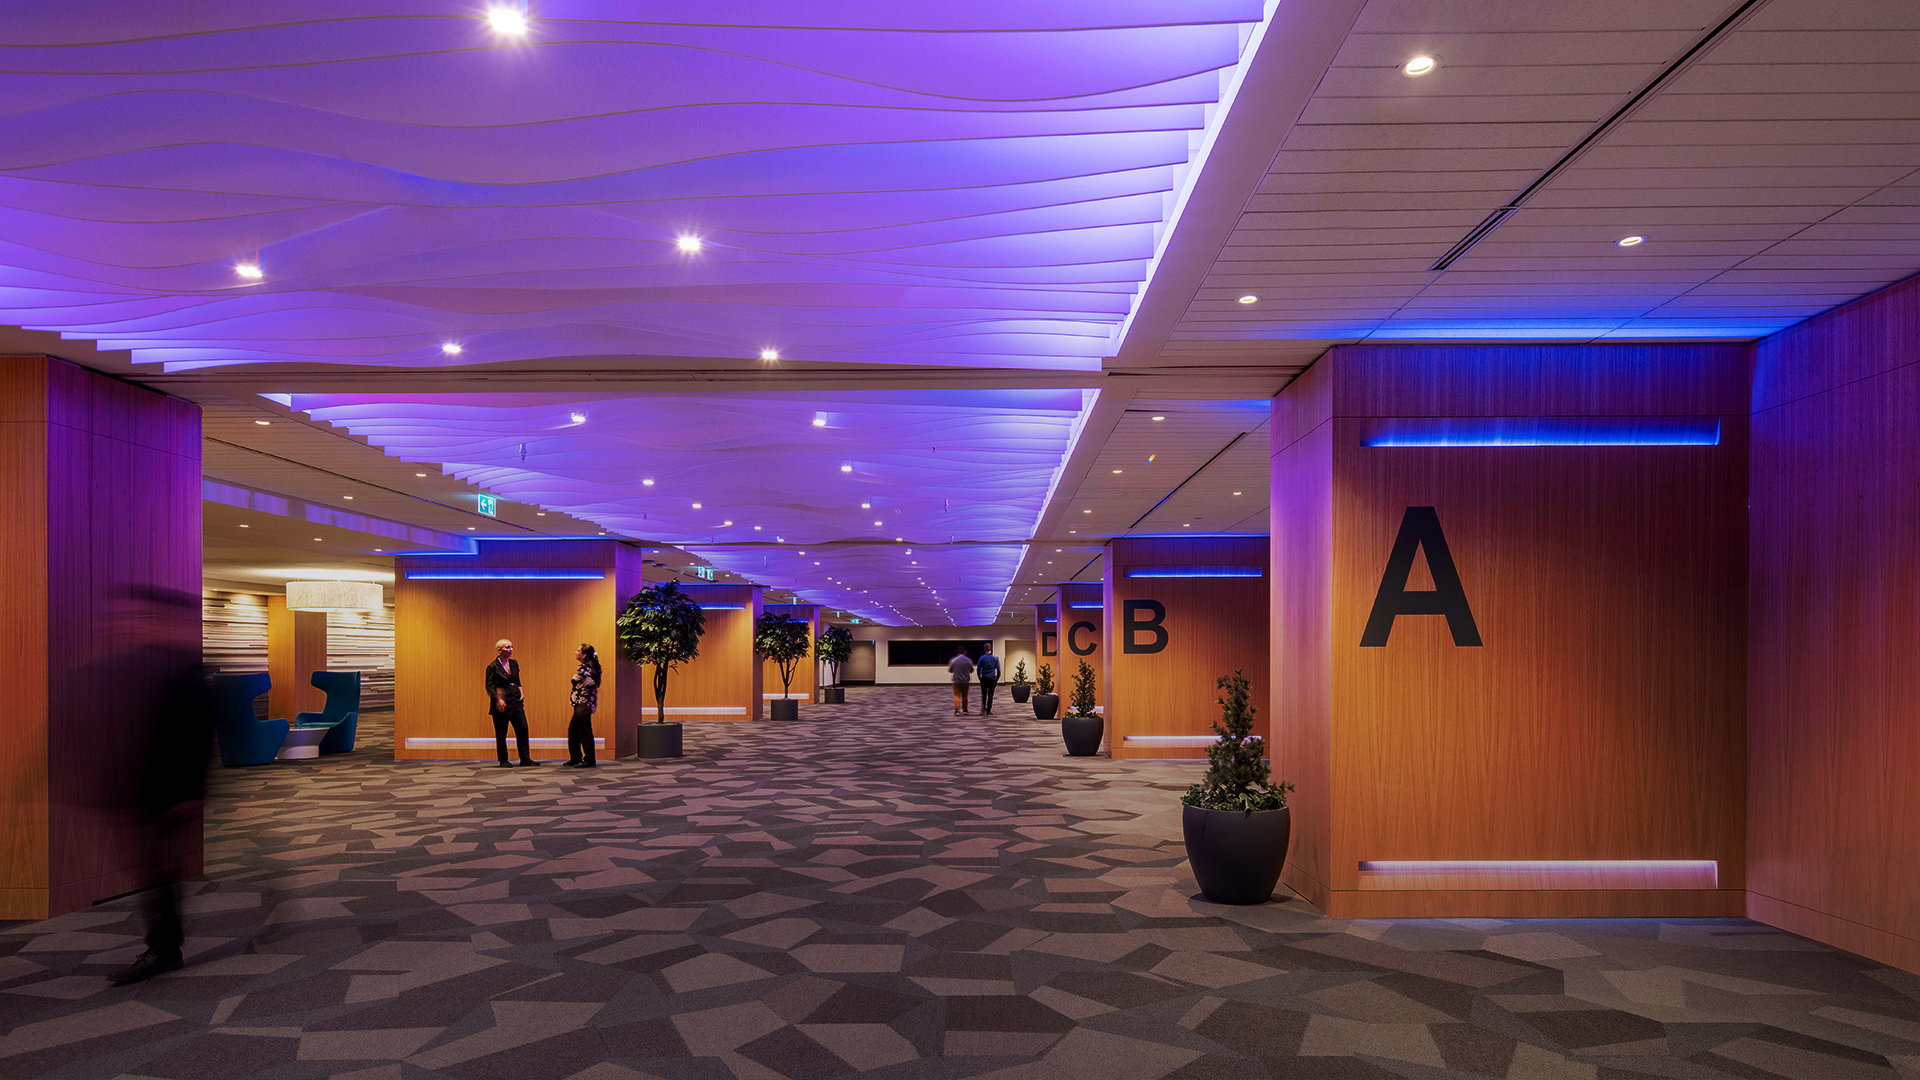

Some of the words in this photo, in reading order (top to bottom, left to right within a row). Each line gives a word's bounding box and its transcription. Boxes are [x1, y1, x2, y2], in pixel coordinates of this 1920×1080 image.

[1359, 506, 1483, 647] A
[1042, 632, 1058, 657] D
[1068, 621, 1098, 656] C
[1123, 600, 1169, 655] B
